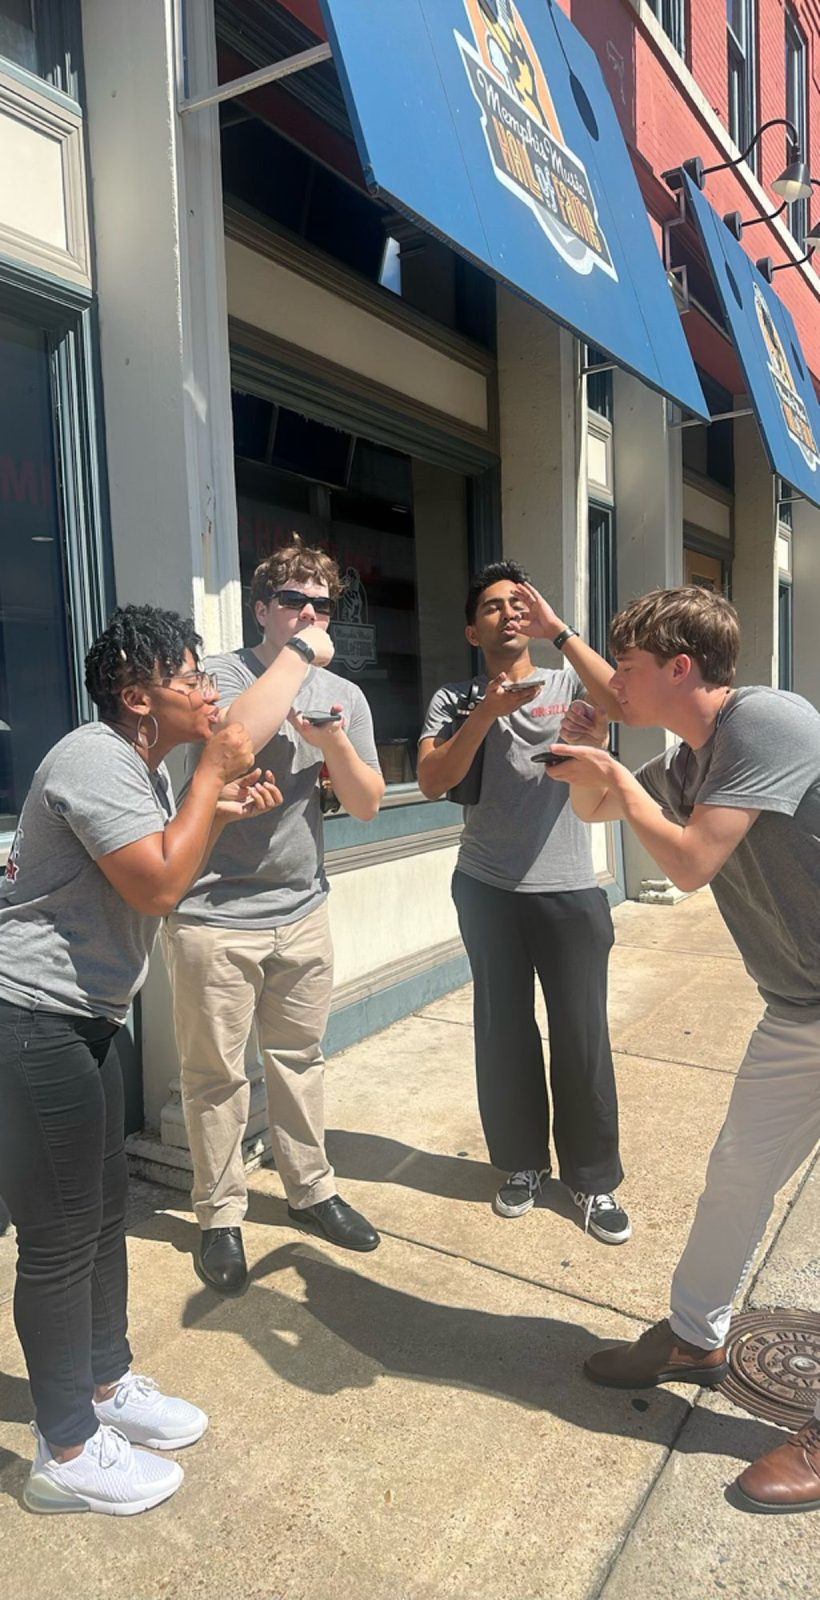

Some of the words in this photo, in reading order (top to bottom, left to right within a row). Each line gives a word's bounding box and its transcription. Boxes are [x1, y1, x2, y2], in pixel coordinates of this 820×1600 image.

[476, 69, 549, 161] Memphis
[544, 138, 588, 200] Music
[492, 115, 544, 200] HALL
[534, 163, 558, 213] of
